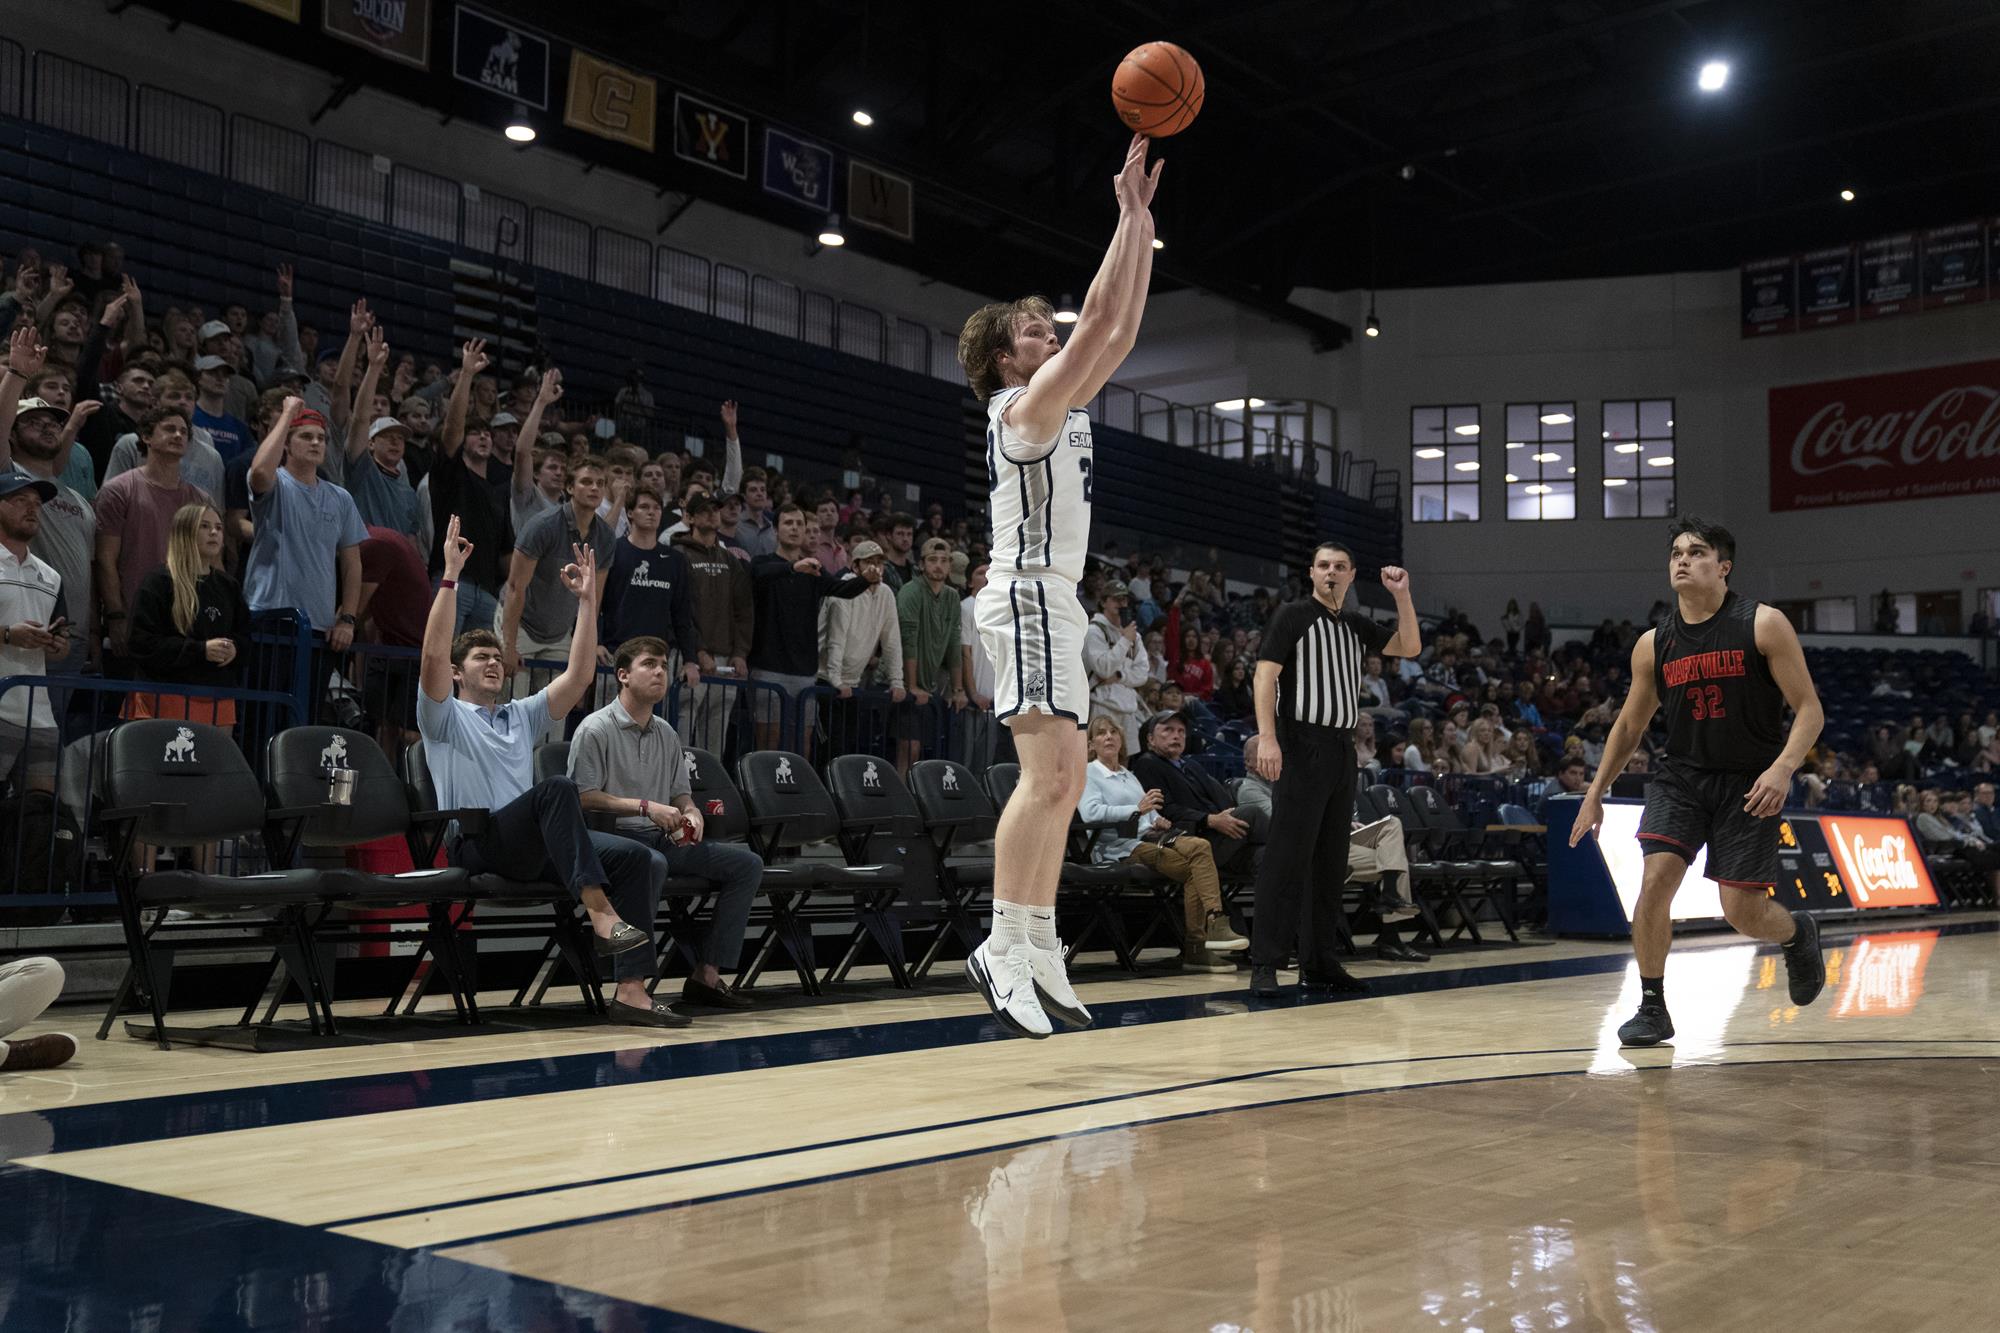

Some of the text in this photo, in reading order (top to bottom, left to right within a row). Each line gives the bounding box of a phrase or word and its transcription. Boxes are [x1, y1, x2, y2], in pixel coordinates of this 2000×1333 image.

[481, 68, 518, 95] SAM
[630, 579, 671, 590] SAMFORD
[1662, 650, 1745, 688] MARYVILLE
[1686, 684, 1726, 720] 32
